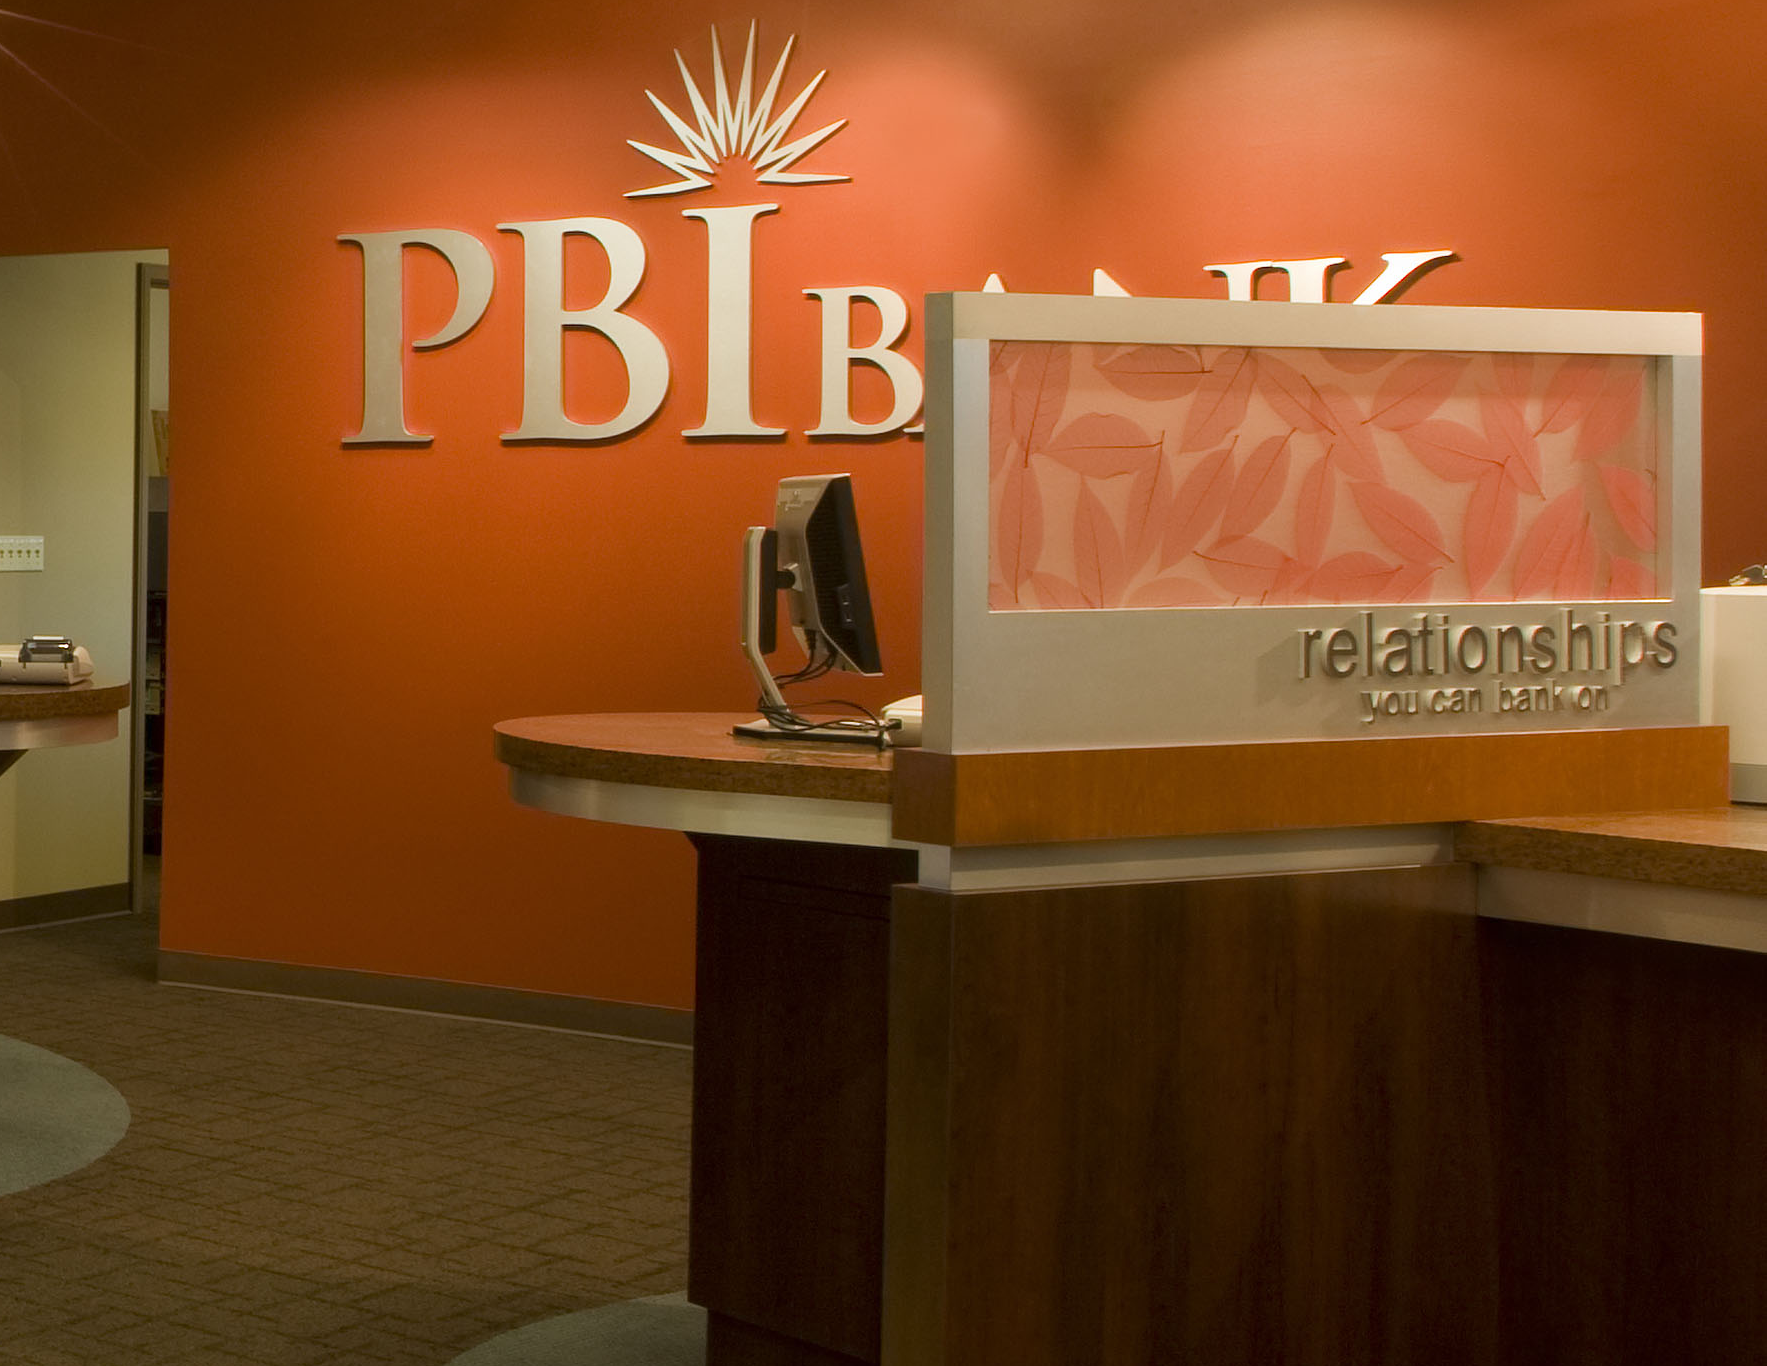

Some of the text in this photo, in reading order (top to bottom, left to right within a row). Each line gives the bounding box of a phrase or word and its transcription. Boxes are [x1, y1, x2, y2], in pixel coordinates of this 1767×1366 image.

[337, 202, 787, 445] PBI
[1299, 608, 1678, 686] relationships
[1360, 678, 1608, 723] you can bank on
